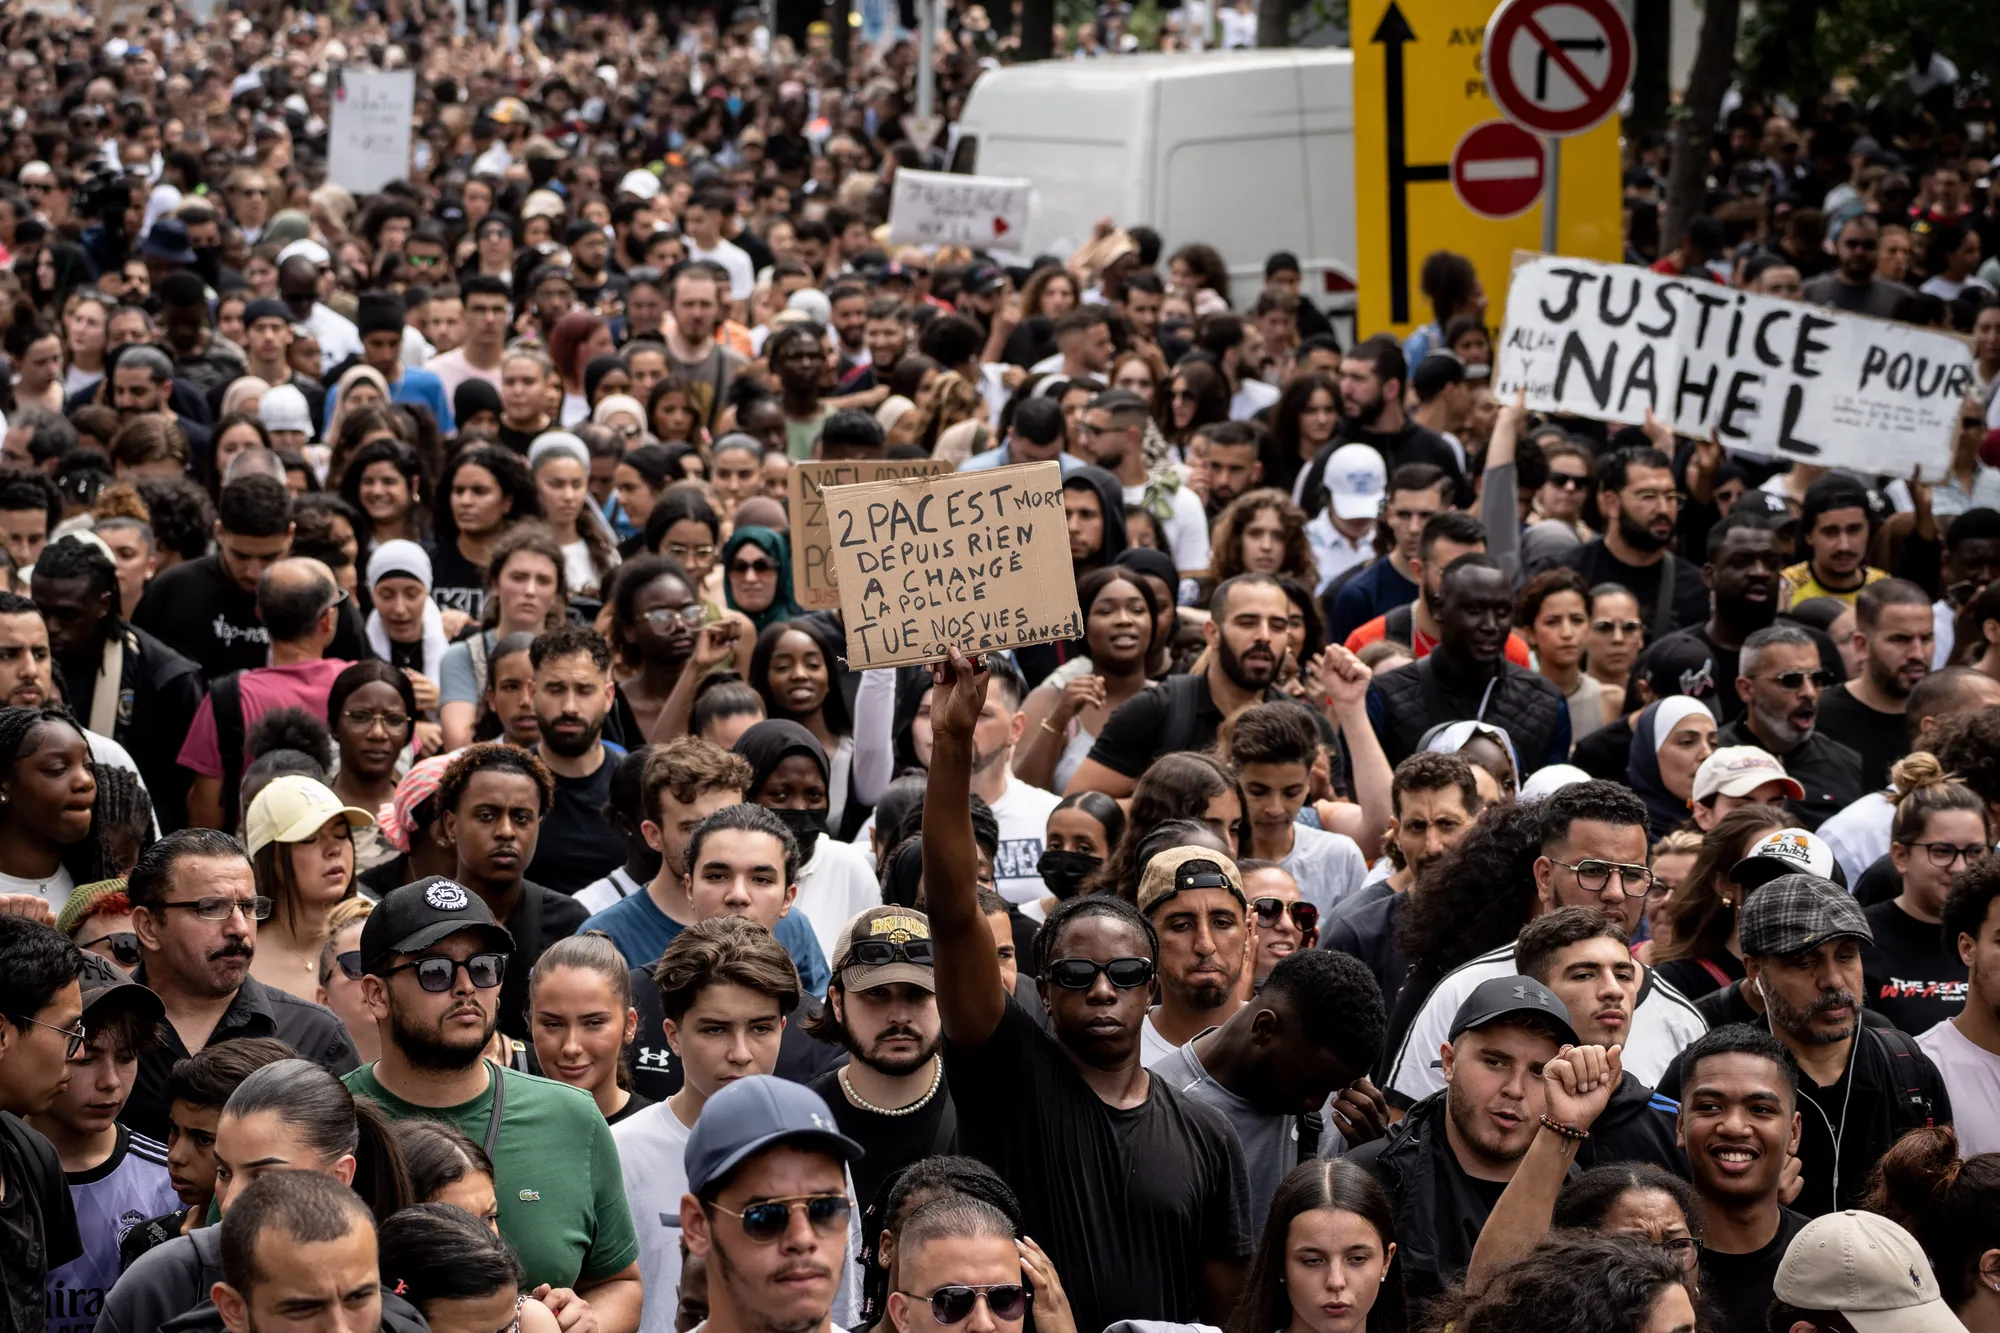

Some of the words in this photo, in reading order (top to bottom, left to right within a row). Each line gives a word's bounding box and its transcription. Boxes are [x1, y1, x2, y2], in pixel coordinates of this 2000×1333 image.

[1540, 267, 1837, 378] JUSTICE
[1859, 344, 1972, 400] POUR
[1553, 330, 1822, 456] NAHEL
[804, 501, 829, 527] Z
[947, 484, 1012, 528] EST
[1013, 488, 1063, 510] MORT
[857, 539, 954, 574] DEPUIS
[863, 577, 884, 601] A
[903, 550, 1023, 593] CHANGÉ
[861, 603, 891, 622] LA
[899, 582, 986, 613] POLICE
[854, 619, 920, 663] TUE
[931, 611, 976, 641] NOS
[980, 607, 1029, 632] VIES
[979, 632, 1007, 649] EN
[870, 915, 929, 939] BRUINS
